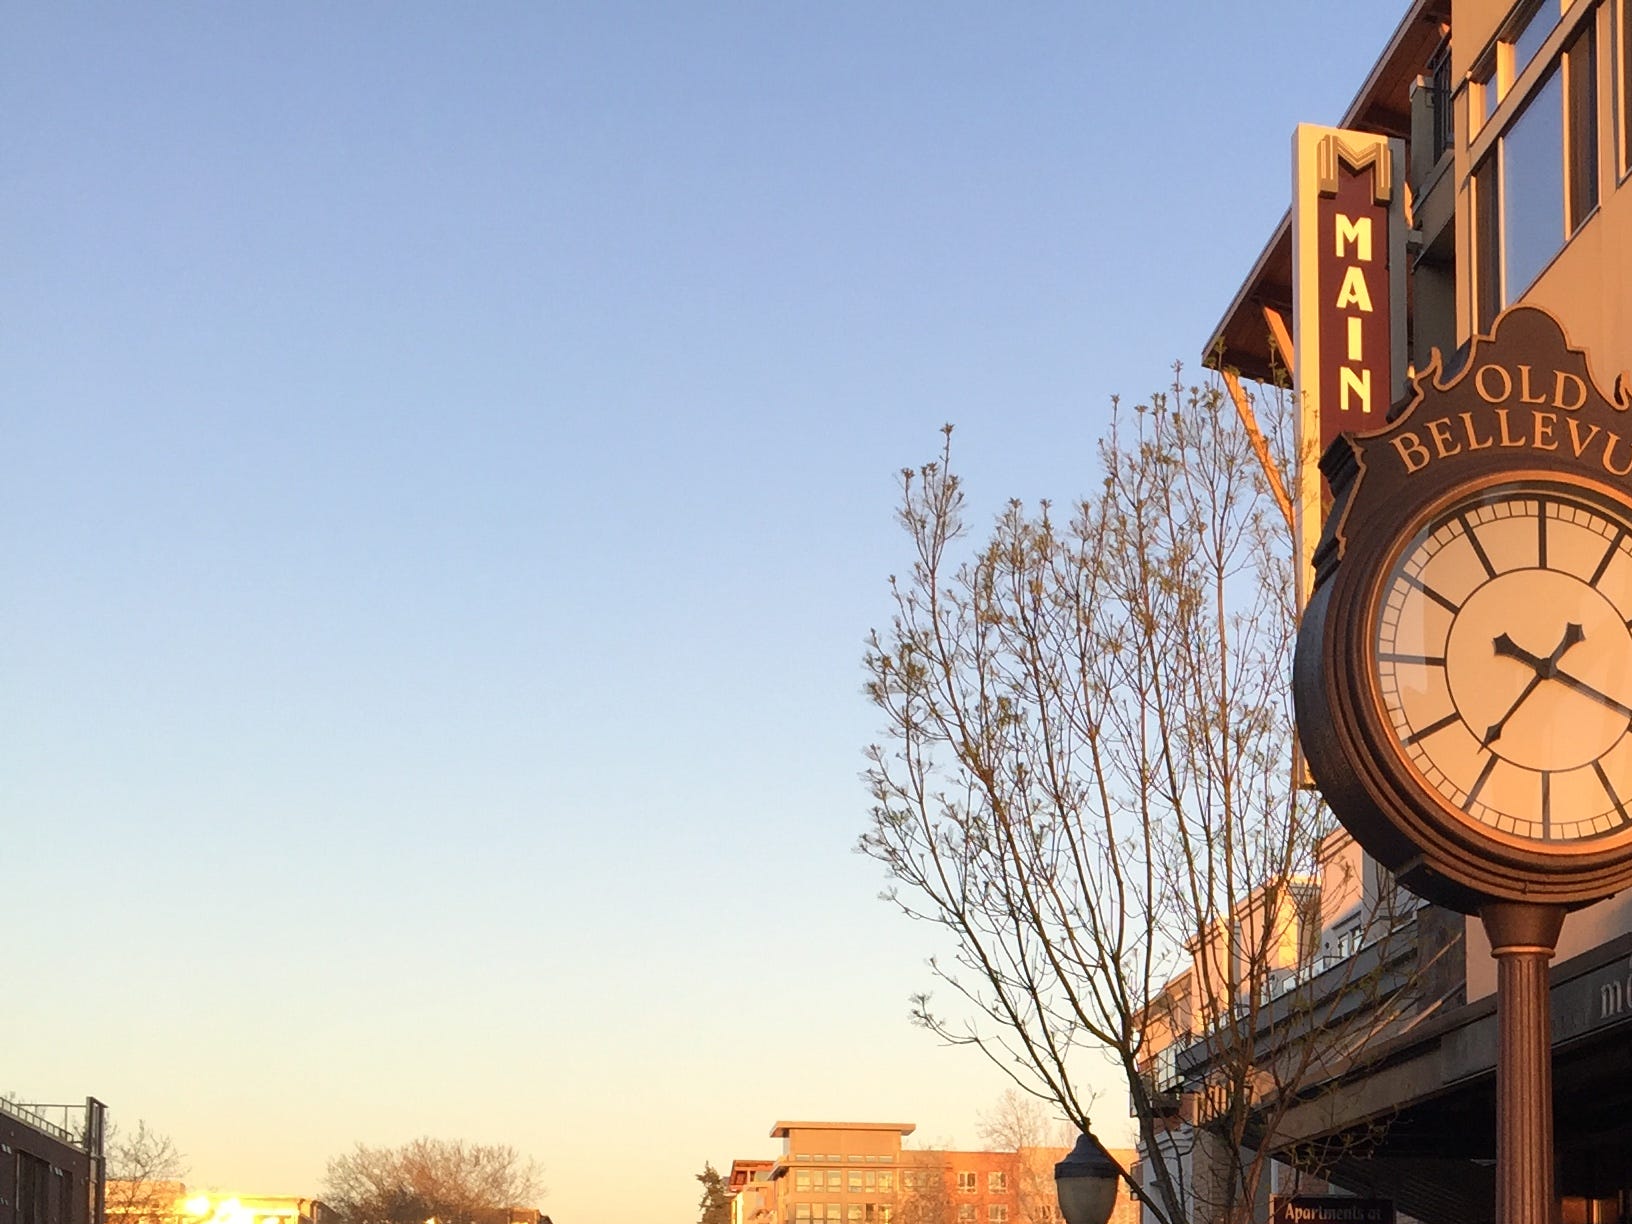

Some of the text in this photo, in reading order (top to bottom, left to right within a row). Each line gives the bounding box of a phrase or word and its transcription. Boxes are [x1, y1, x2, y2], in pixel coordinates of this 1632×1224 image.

[1335, 213, 1373, 414] MAIN
[1475, 363, 1588, 411] OLD
[1285, 1203, 1364, 1223] Apartments
